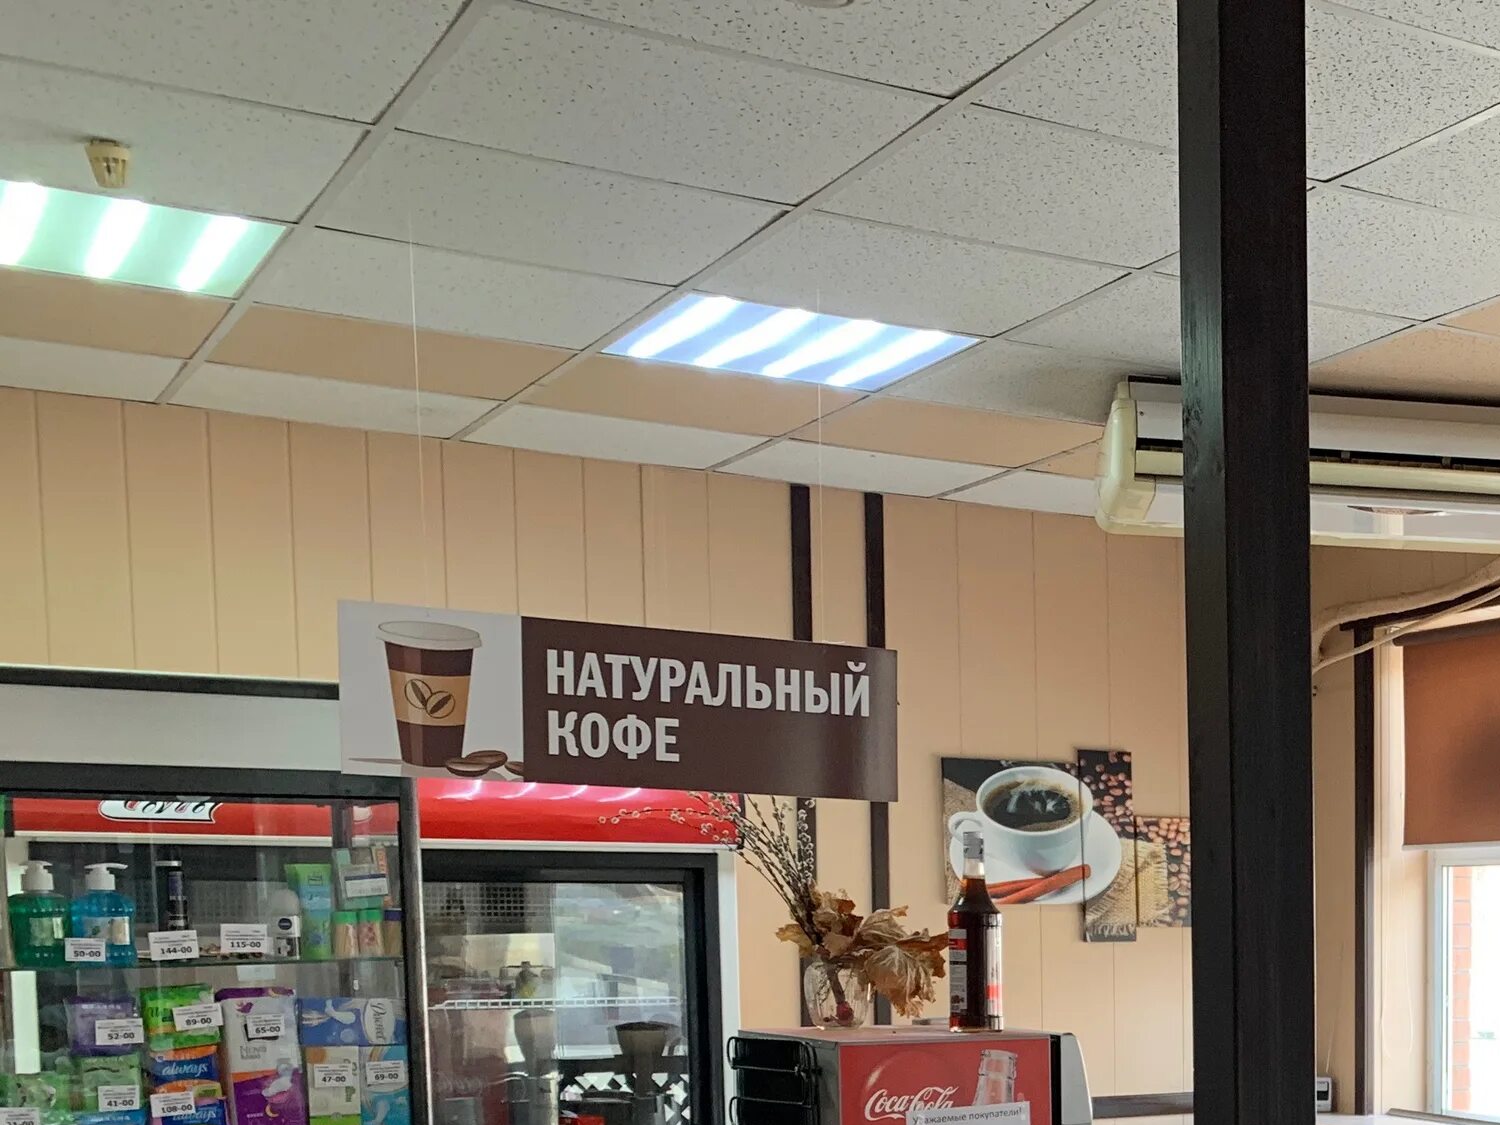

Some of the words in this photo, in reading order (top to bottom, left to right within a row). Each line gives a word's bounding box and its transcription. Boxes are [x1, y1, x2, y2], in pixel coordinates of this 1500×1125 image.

[546, 648, 871, 718] НАТУРАЛЬНЫЙ
[547, 710, 680, 763] КОФЕ
[230, 940, 262, 949] 115-00
[73, 949, 101, 958] 50-00
[160, 946, 193, 955] 144-00
[185, 1017, 212, 1026] 89-00
[255, 1025, 281, 1035] 65-00
[107, 1032, 135, 1040] 52-00
[161, 1062, 209, 1077] always
[321, 1075, 346, 1083] 47-00
[374, 1073, 399, 1081] 69-00
[107, 1099, 135, 1107] 41-00
[864, 1086, 959, 1121] Coca-Cola
[913, 1114, 966, 1125] Уажаемые
[969, 1107, 1022, 1120] покупатели!
